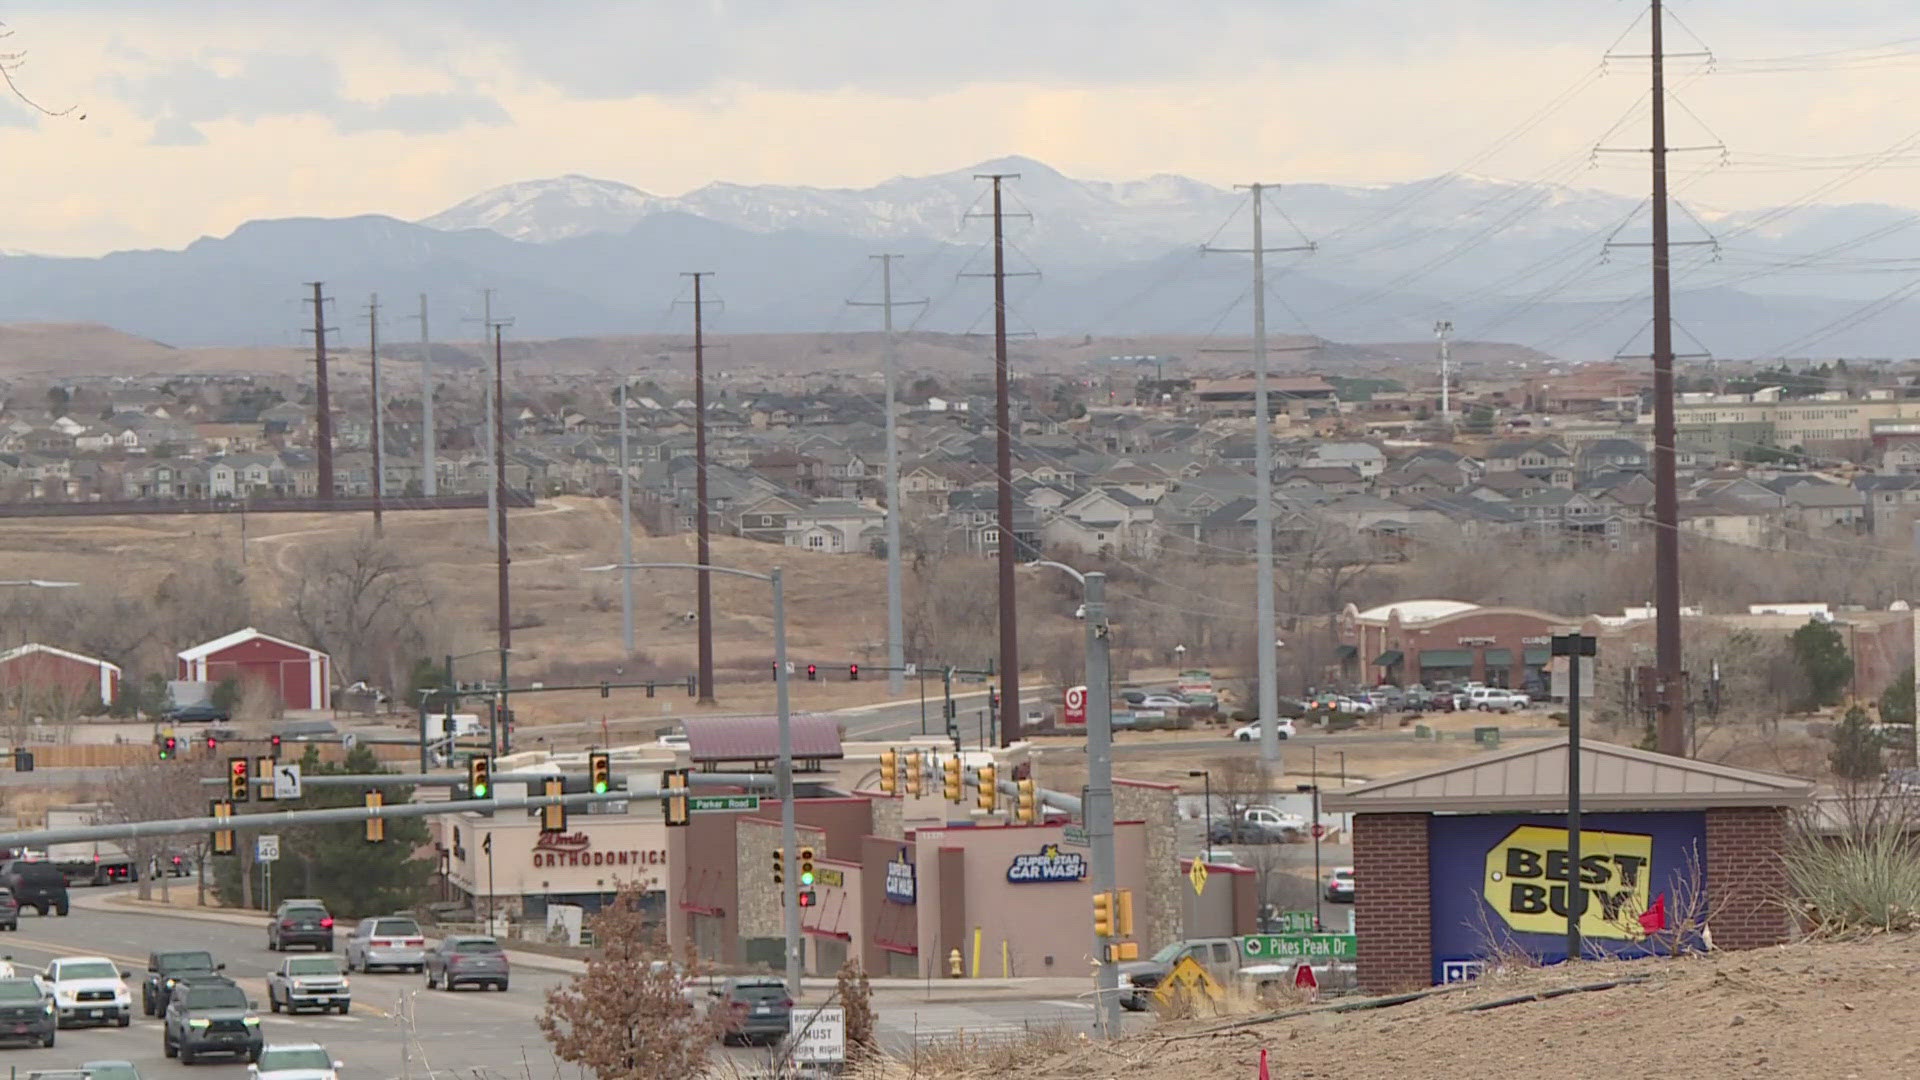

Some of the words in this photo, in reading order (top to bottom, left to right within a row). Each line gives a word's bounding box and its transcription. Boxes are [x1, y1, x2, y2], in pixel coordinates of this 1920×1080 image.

[696, 799, 723, 809] Parker
[728, 799, 749, 809] Road
[261, 847, 278, 857] 40
[1016, 856, 1050, 866] SUPER
[1053, 855, 1080, 865] STAR
[1009, 865, 1040, 879] CAR
[1043, 864, 1085, 878] WASH
[1506, 847, 1647, 887] BEST
[1510, 882, 1633, 921] BUY
[1270, 938, 1300, 955] Pikes
[1303, 938, 1330, 955] Peak
[1333, 938, 1347, 954] Dr
[804, 1028, 832, 1040] MUST
[819, 1045, 841, 1055] RIGHT
